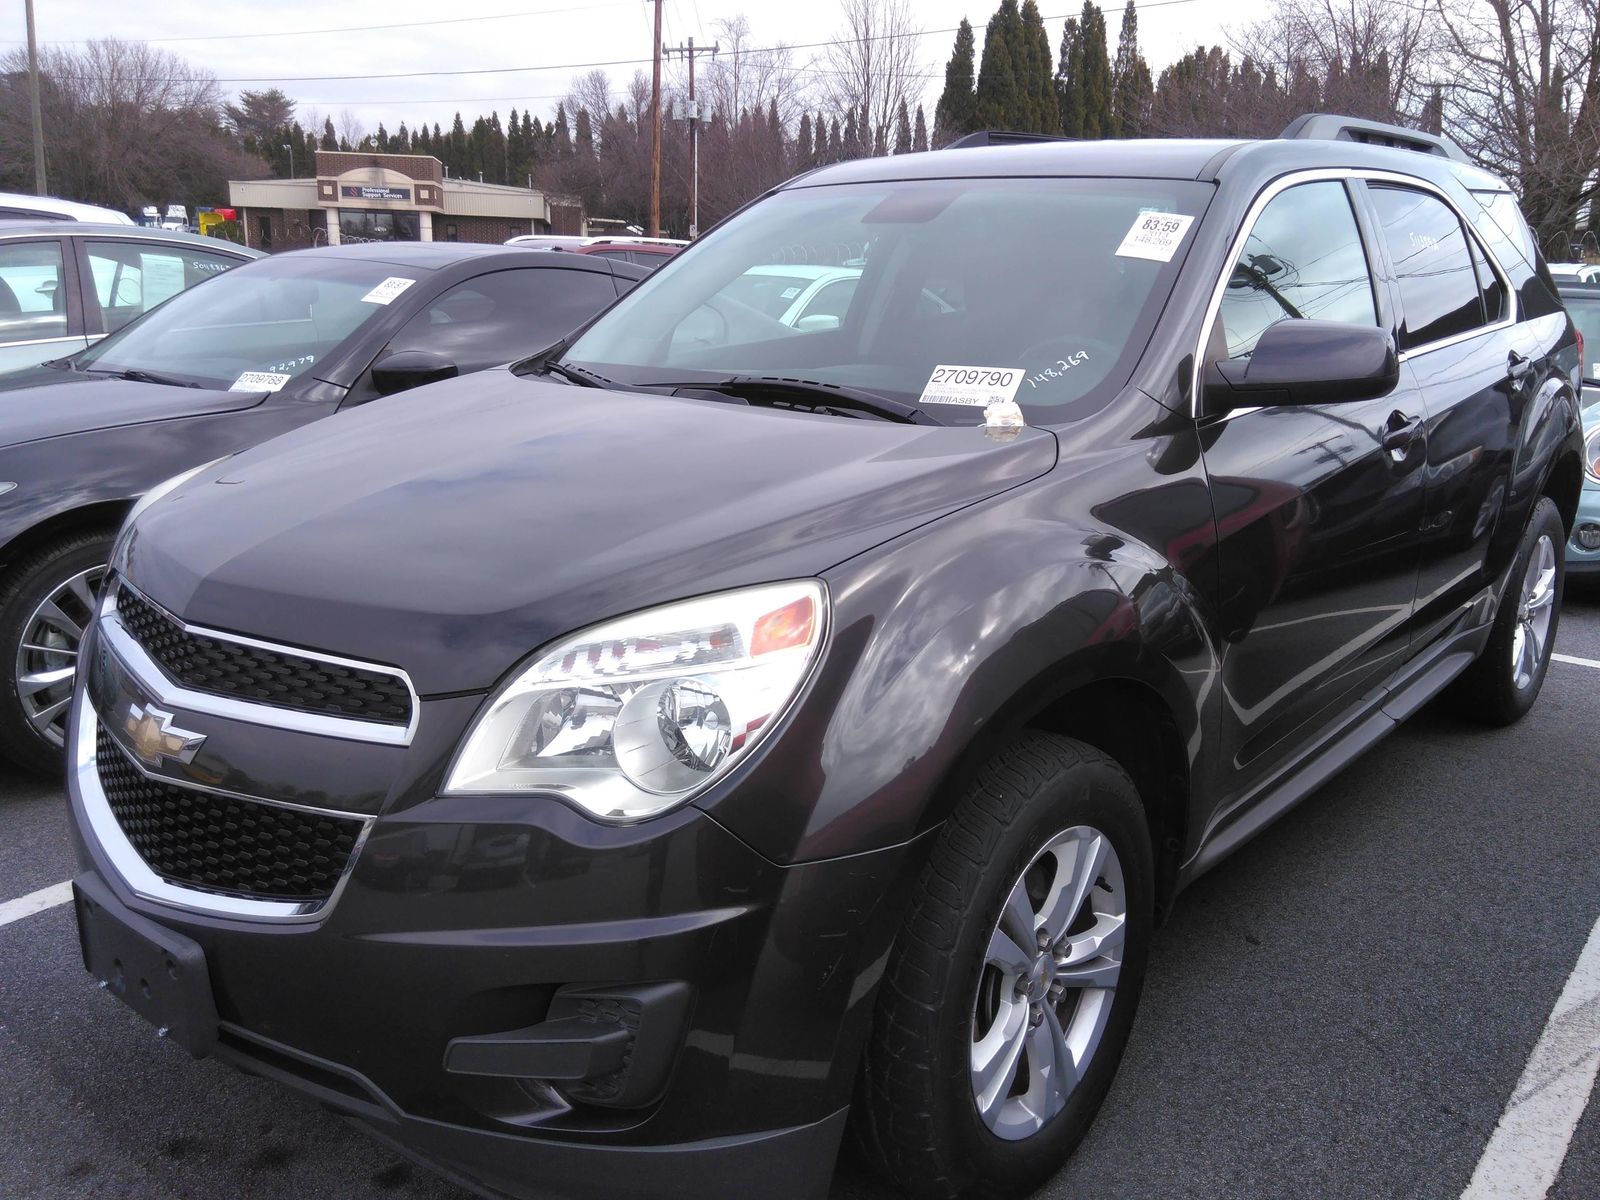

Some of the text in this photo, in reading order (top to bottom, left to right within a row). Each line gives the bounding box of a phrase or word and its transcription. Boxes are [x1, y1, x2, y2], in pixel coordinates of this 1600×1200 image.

[1142, 219, 1180, 233] 83:59
[1026, 350, 1090, 388] 148,269
[238, 373, 284, 386] 2709788
[931, 368, 1014, 387] 2709790
